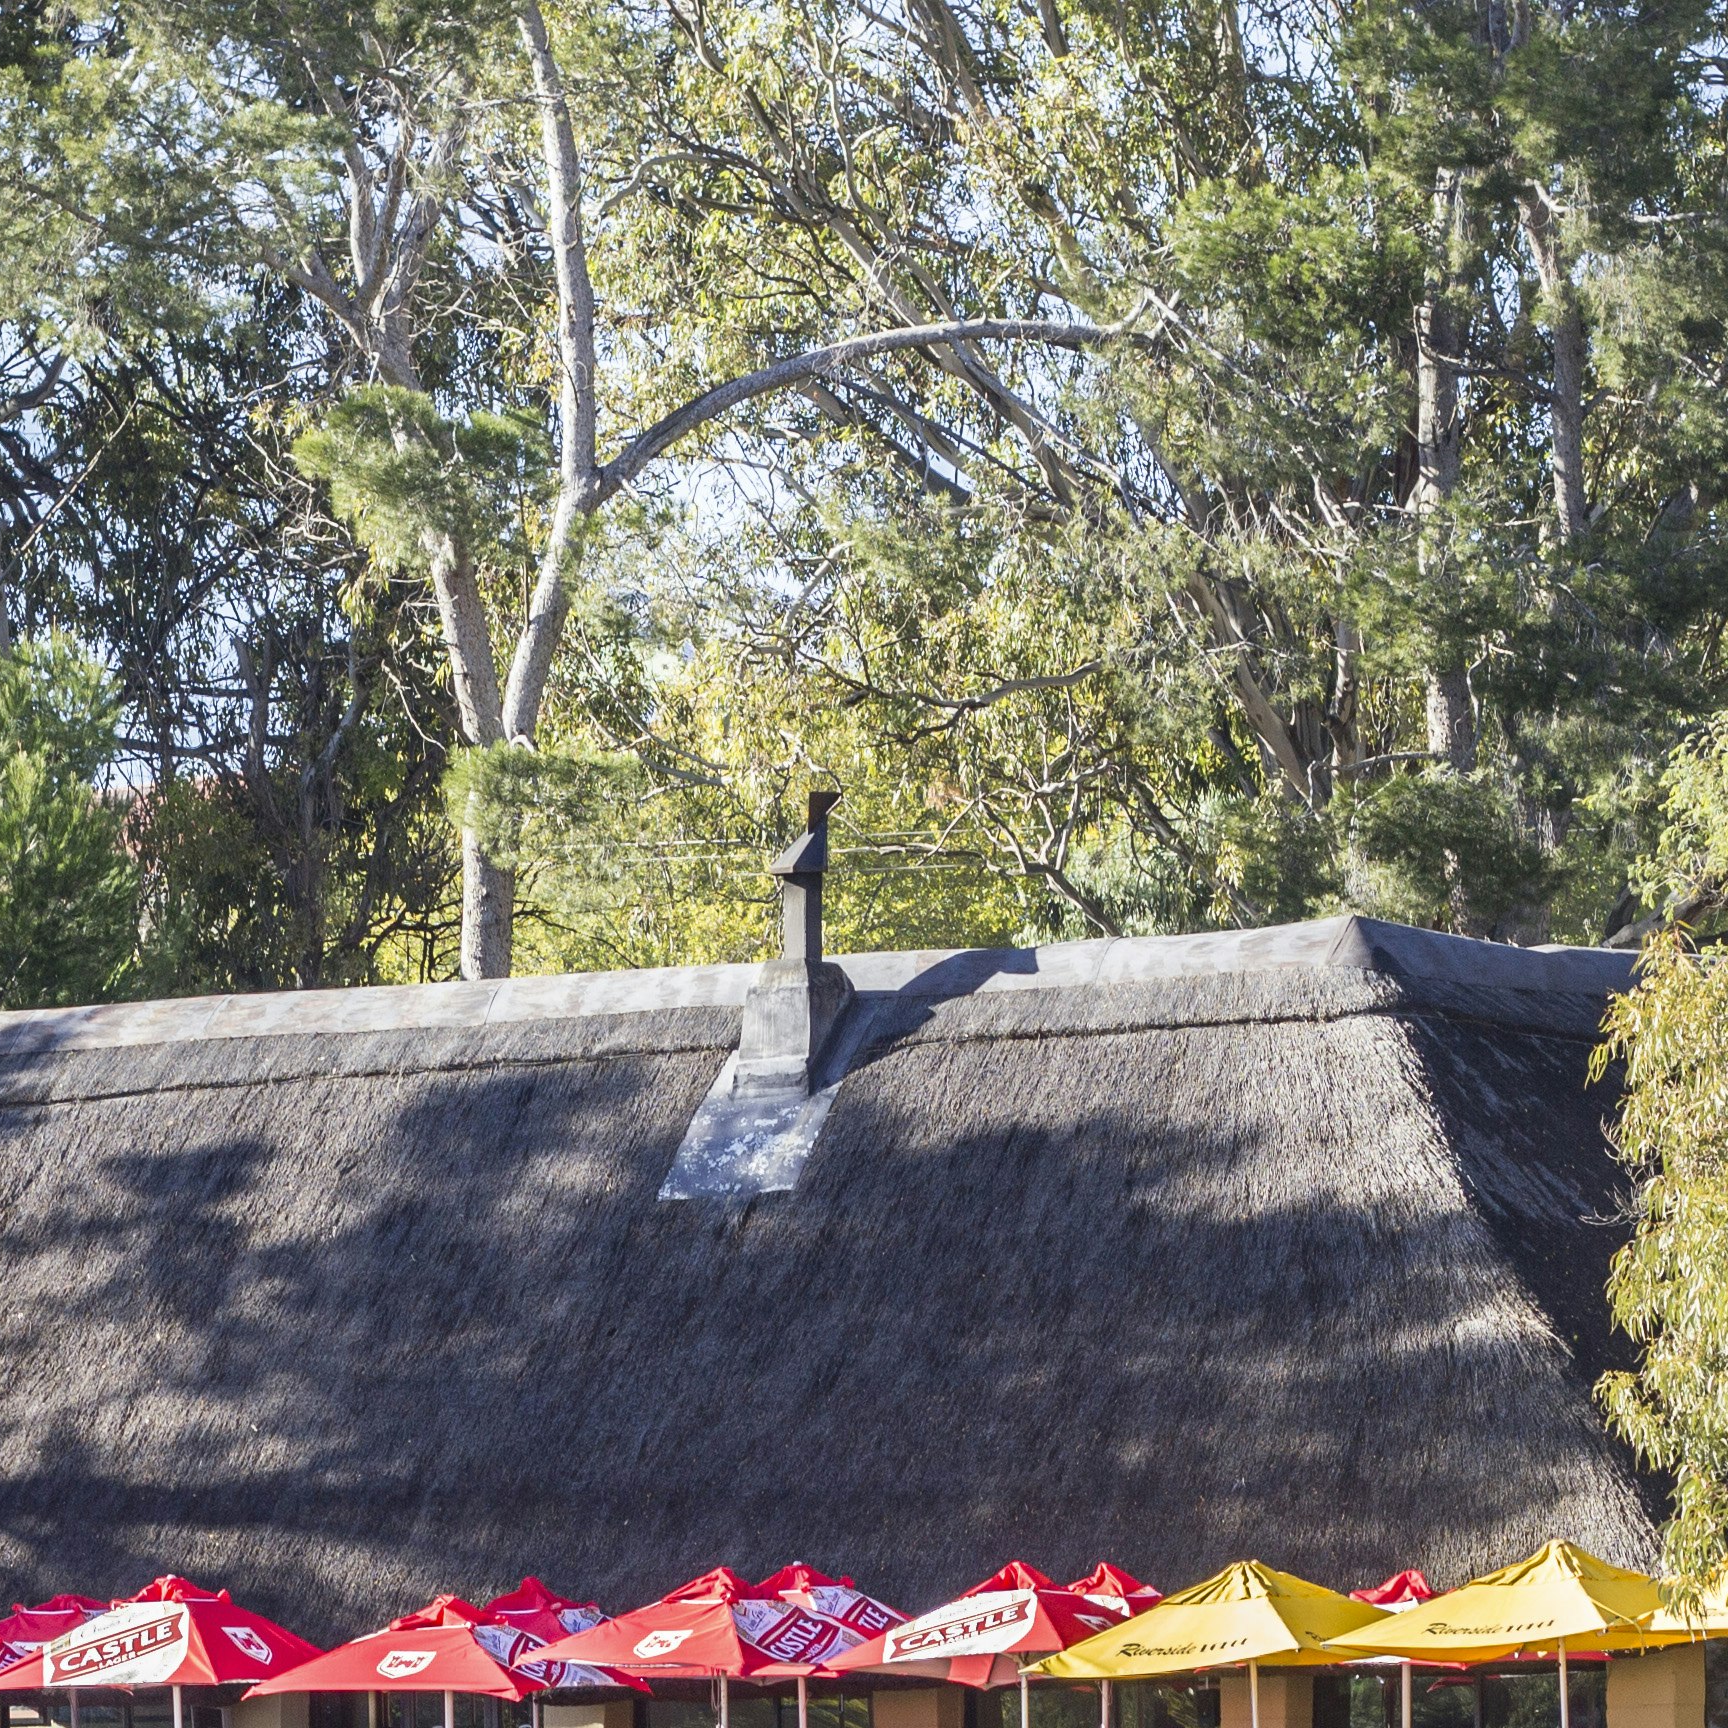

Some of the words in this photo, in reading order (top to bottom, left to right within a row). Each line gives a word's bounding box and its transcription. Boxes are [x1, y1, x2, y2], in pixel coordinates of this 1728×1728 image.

[858, 1606, 889, 1631] TLE
[900, 1605, 1020, 1650] CASTLE
[1421, 1621, 1504, 1636] Riverside
[59, 1621, 173, 1672] CASTLE
[770, 1618, 823, 1659] CASTLE
[1115, 1642, 1197, 1658] Riverside
